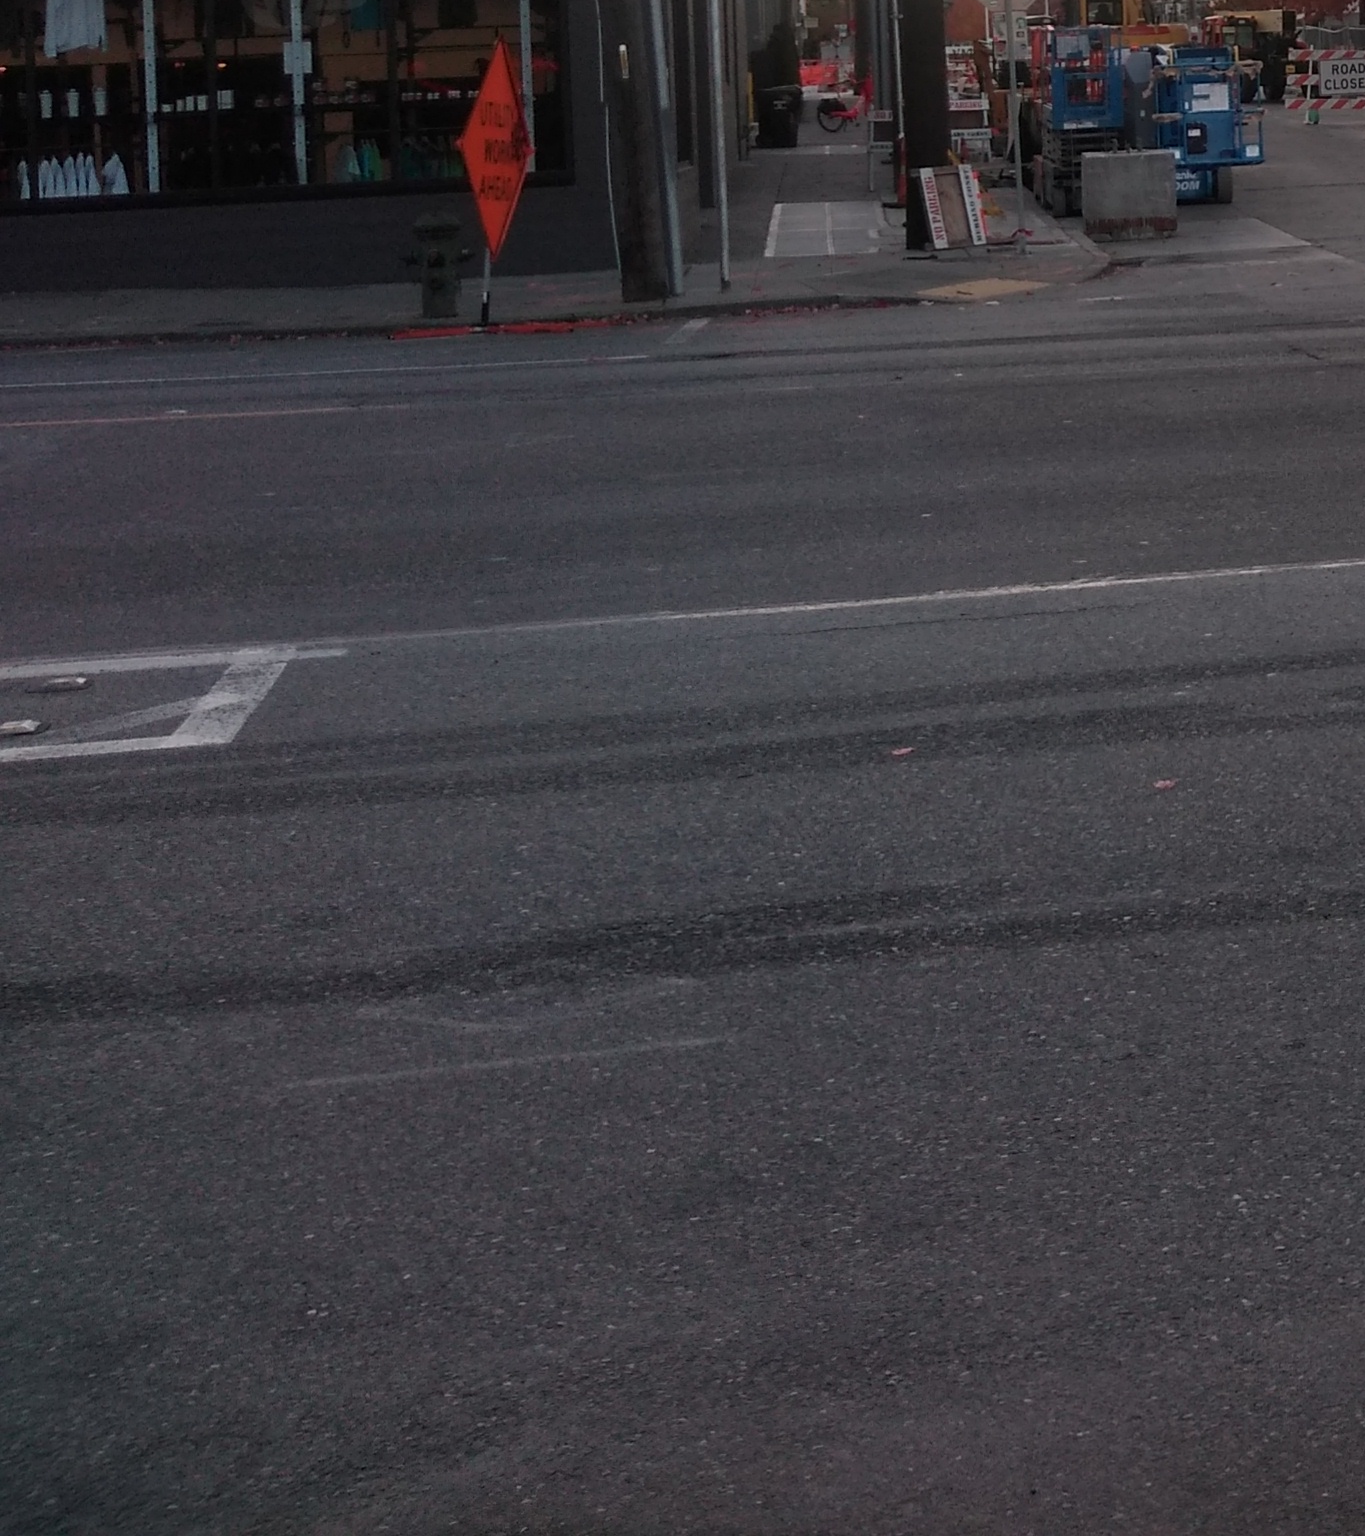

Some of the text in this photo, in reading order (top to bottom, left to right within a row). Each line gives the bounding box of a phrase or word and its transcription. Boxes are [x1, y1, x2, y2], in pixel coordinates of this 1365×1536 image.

[1331, 62, 1365, 75] ROAD
[484, 139, 516, 164] WORK
[480, 175, 516, 201] AHEAD
[925, 175, 946, 241] NO PARKING
